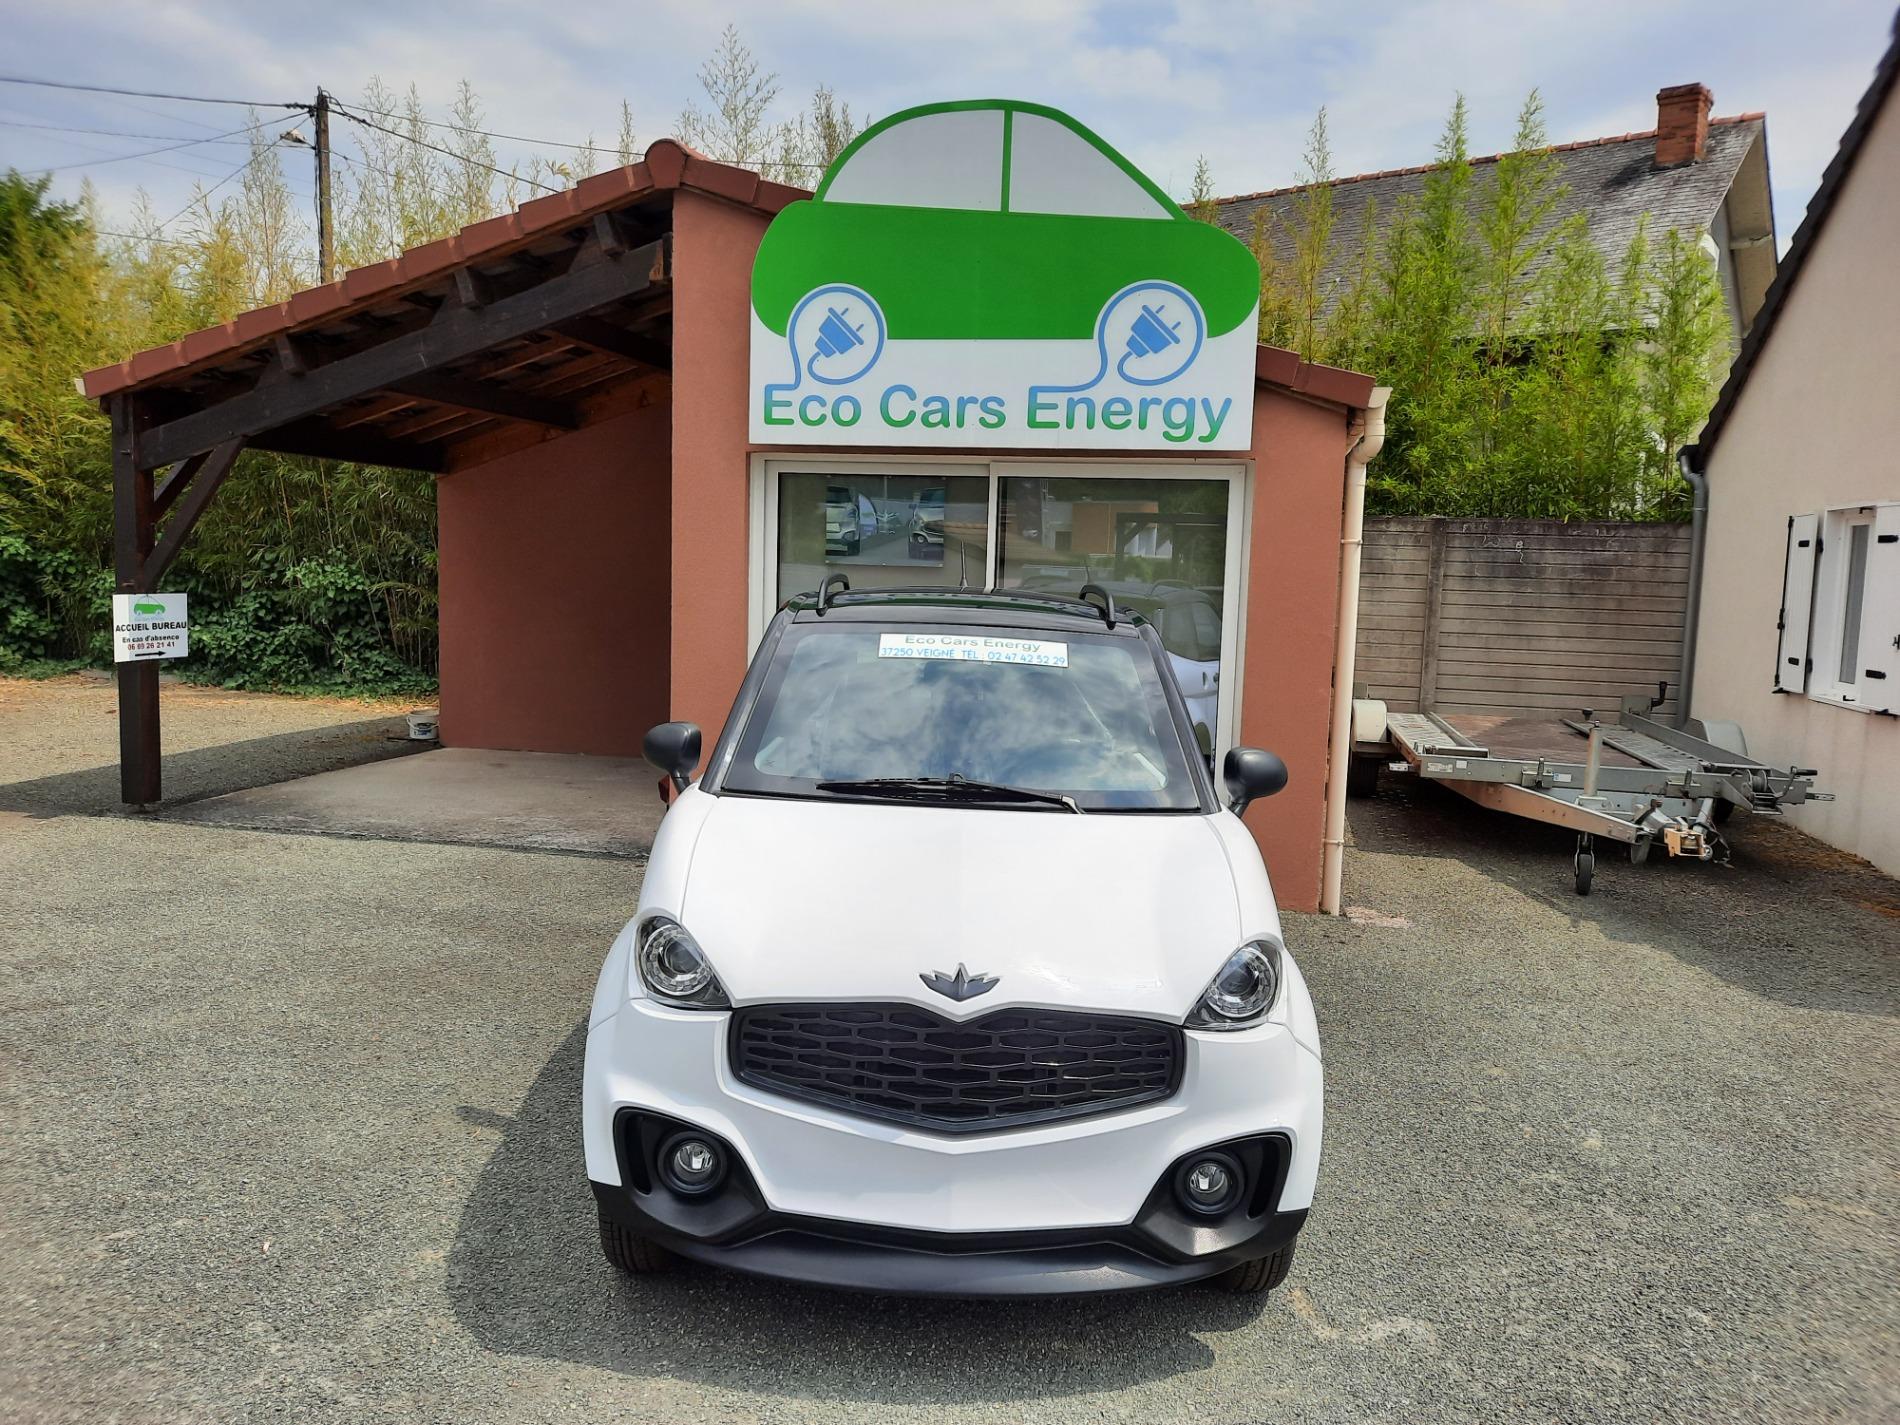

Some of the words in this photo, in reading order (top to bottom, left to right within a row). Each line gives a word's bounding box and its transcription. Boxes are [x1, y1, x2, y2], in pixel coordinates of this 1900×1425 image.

[764, 384, 862, 427] Eco
[880, 384, 1006, 429] Cars
[1027, 386, 1232, 443] Energy
[115, 623, 150, 632] ACCUEIL
[152, 621, 187, 630] BUREAU
[145, 634, 180, 642] d'absence
[905, 635, 936, 644] Eco
[941, 637, 979, 646] Cars
[983, 638, 1041, 652] Energy
[881, 647, 913, 657] 37250
[987, 651, 1002, 660] 02
[1005, 652, 1017, 662] 47
[1020, 653, 1034, 663] 42
[1036, 655, 1050, 664] 52
[1053, 656, 1066, 666] 29
